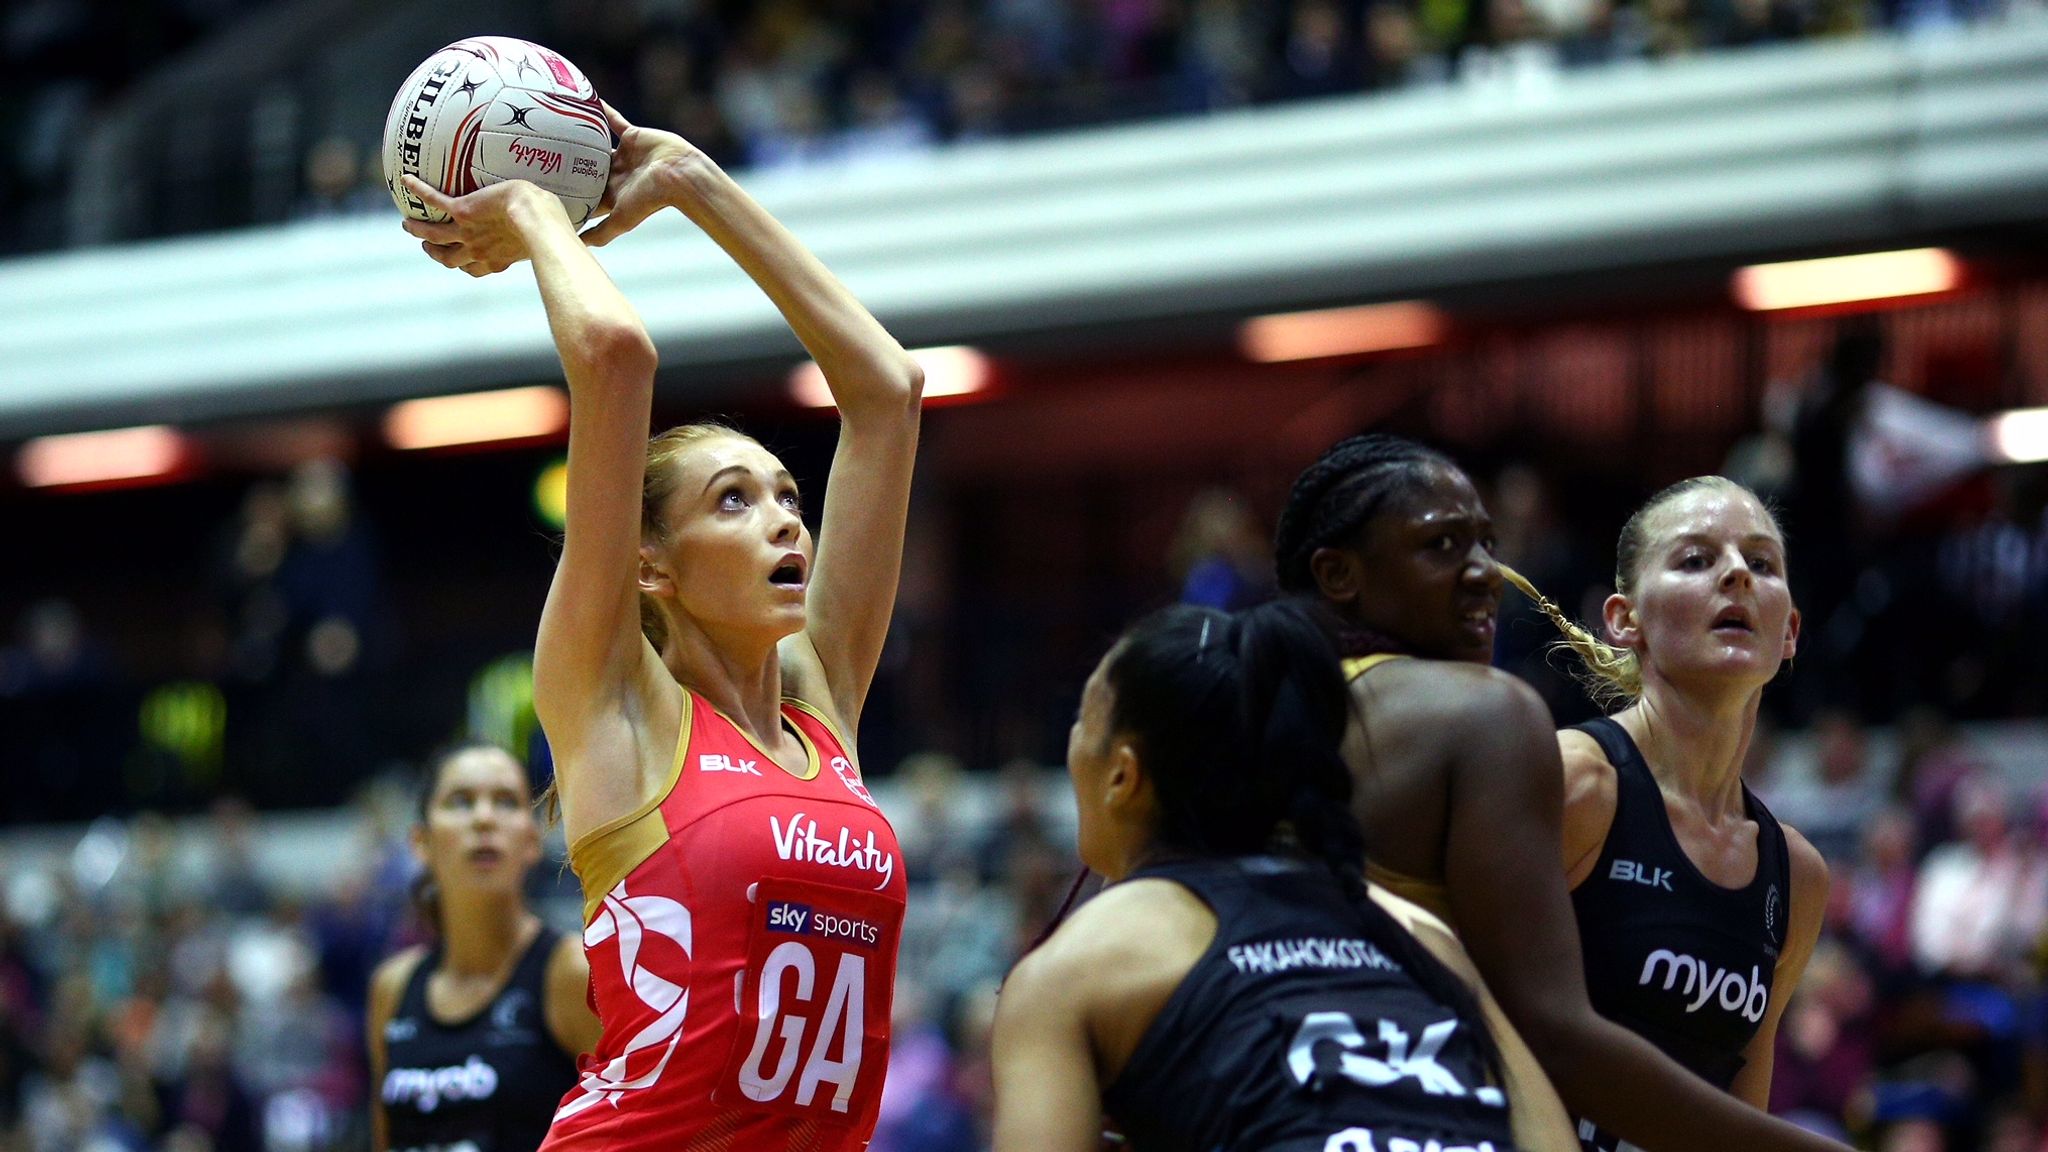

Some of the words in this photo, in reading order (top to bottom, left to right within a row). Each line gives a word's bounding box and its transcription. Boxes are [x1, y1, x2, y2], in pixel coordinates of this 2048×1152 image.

[508, 136, 562, 175] Vitality
[572, 166, 599, 179] England
[573, 157, 598, 168] netball
[700, 754, 763, 777] BLK
[769, 812, 893, 891] Vitality
[1609, 859, 1675, 893] BLK
[770, 903, 808, 932] sky
[813, 912, 879, 944] sports
[1227, 936, 1402, 975] FAKAHOKOTA
[1639, 948, 1768, 1023] myob
[738, 941, 867, 1113] GA
